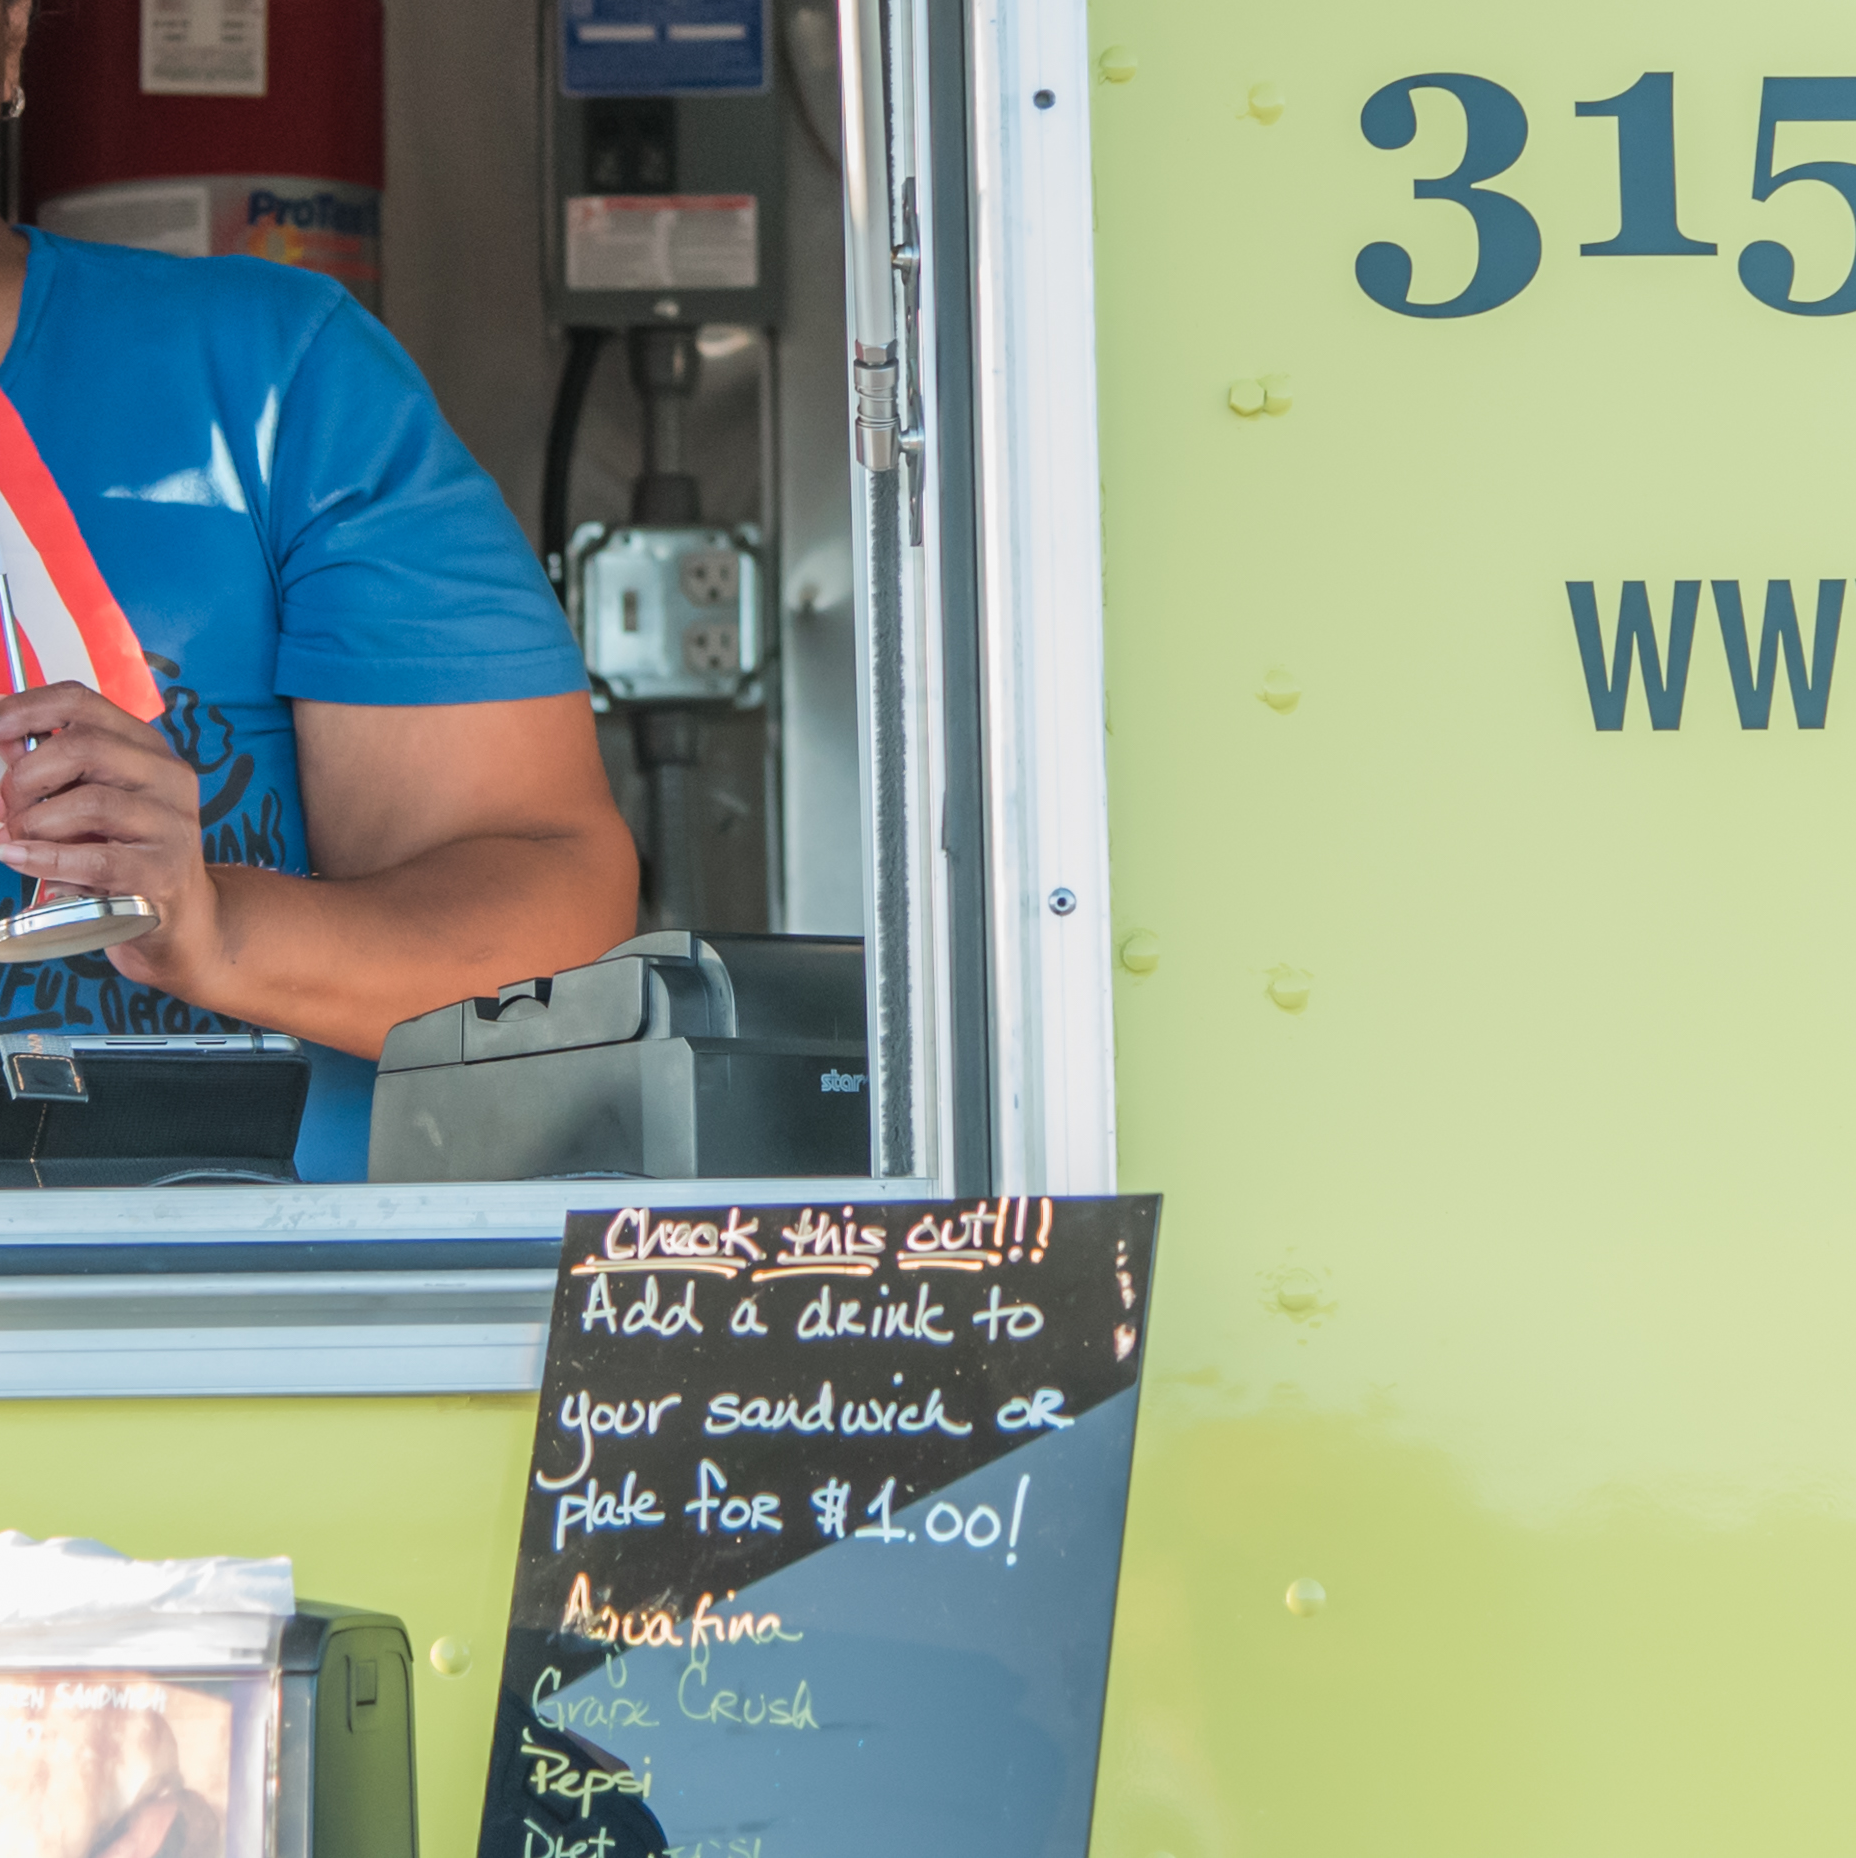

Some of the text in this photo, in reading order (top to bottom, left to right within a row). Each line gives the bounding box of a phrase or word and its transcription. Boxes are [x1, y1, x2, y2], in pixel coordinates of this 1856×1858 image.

[605, 1205, 767, 1261] Check
[783, 1204, 887, 1257] this
[581, 1272, 704, 1337] Add
[730, 1298, 769, 1336] a
[972, 1283, 1045, 1342] to
[536, 1389, 682, 1490] your
[704, 1372, 974, 1435] sandwich
[552, 1469, 665, 1552] plate
[520, 1736, 653, 1819] Pepsi
